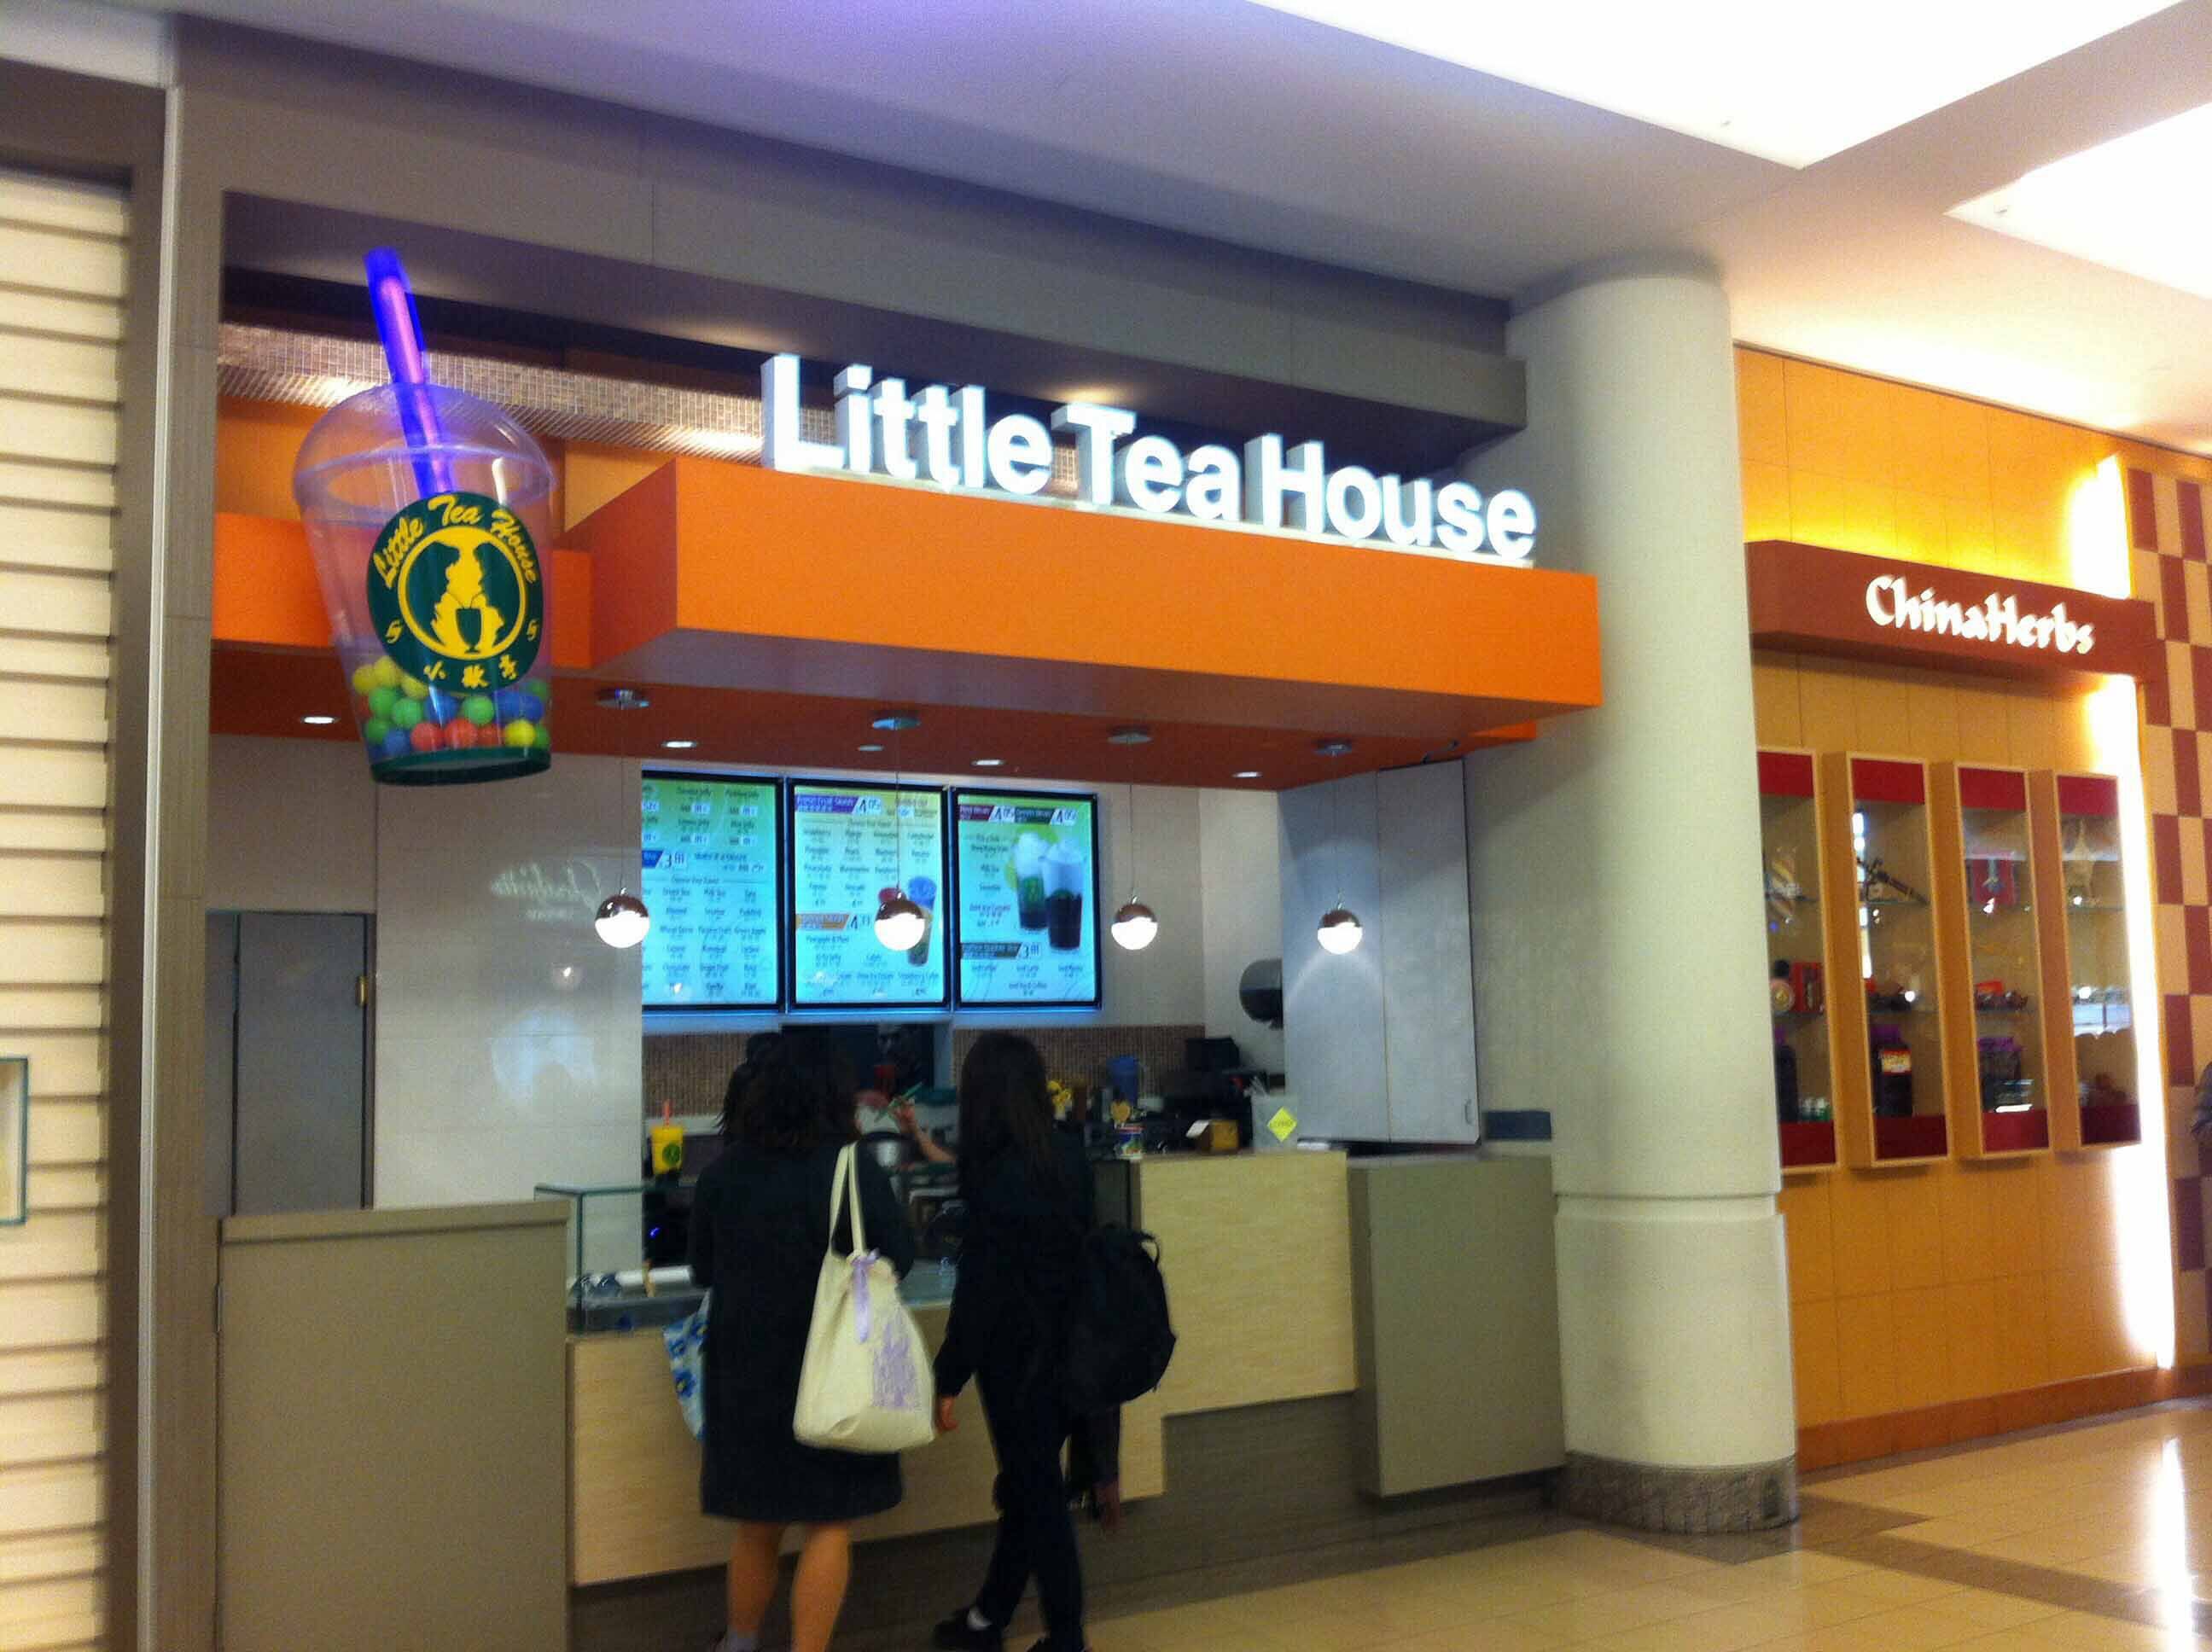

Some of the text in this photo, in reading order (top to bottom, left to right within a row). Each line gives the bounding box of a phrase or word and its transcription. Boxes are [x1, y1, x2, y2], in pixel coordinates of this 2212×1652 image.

[763, 352, 1536, 560] Little Tea House
[373, 494, 537, 589] Little Tea House
